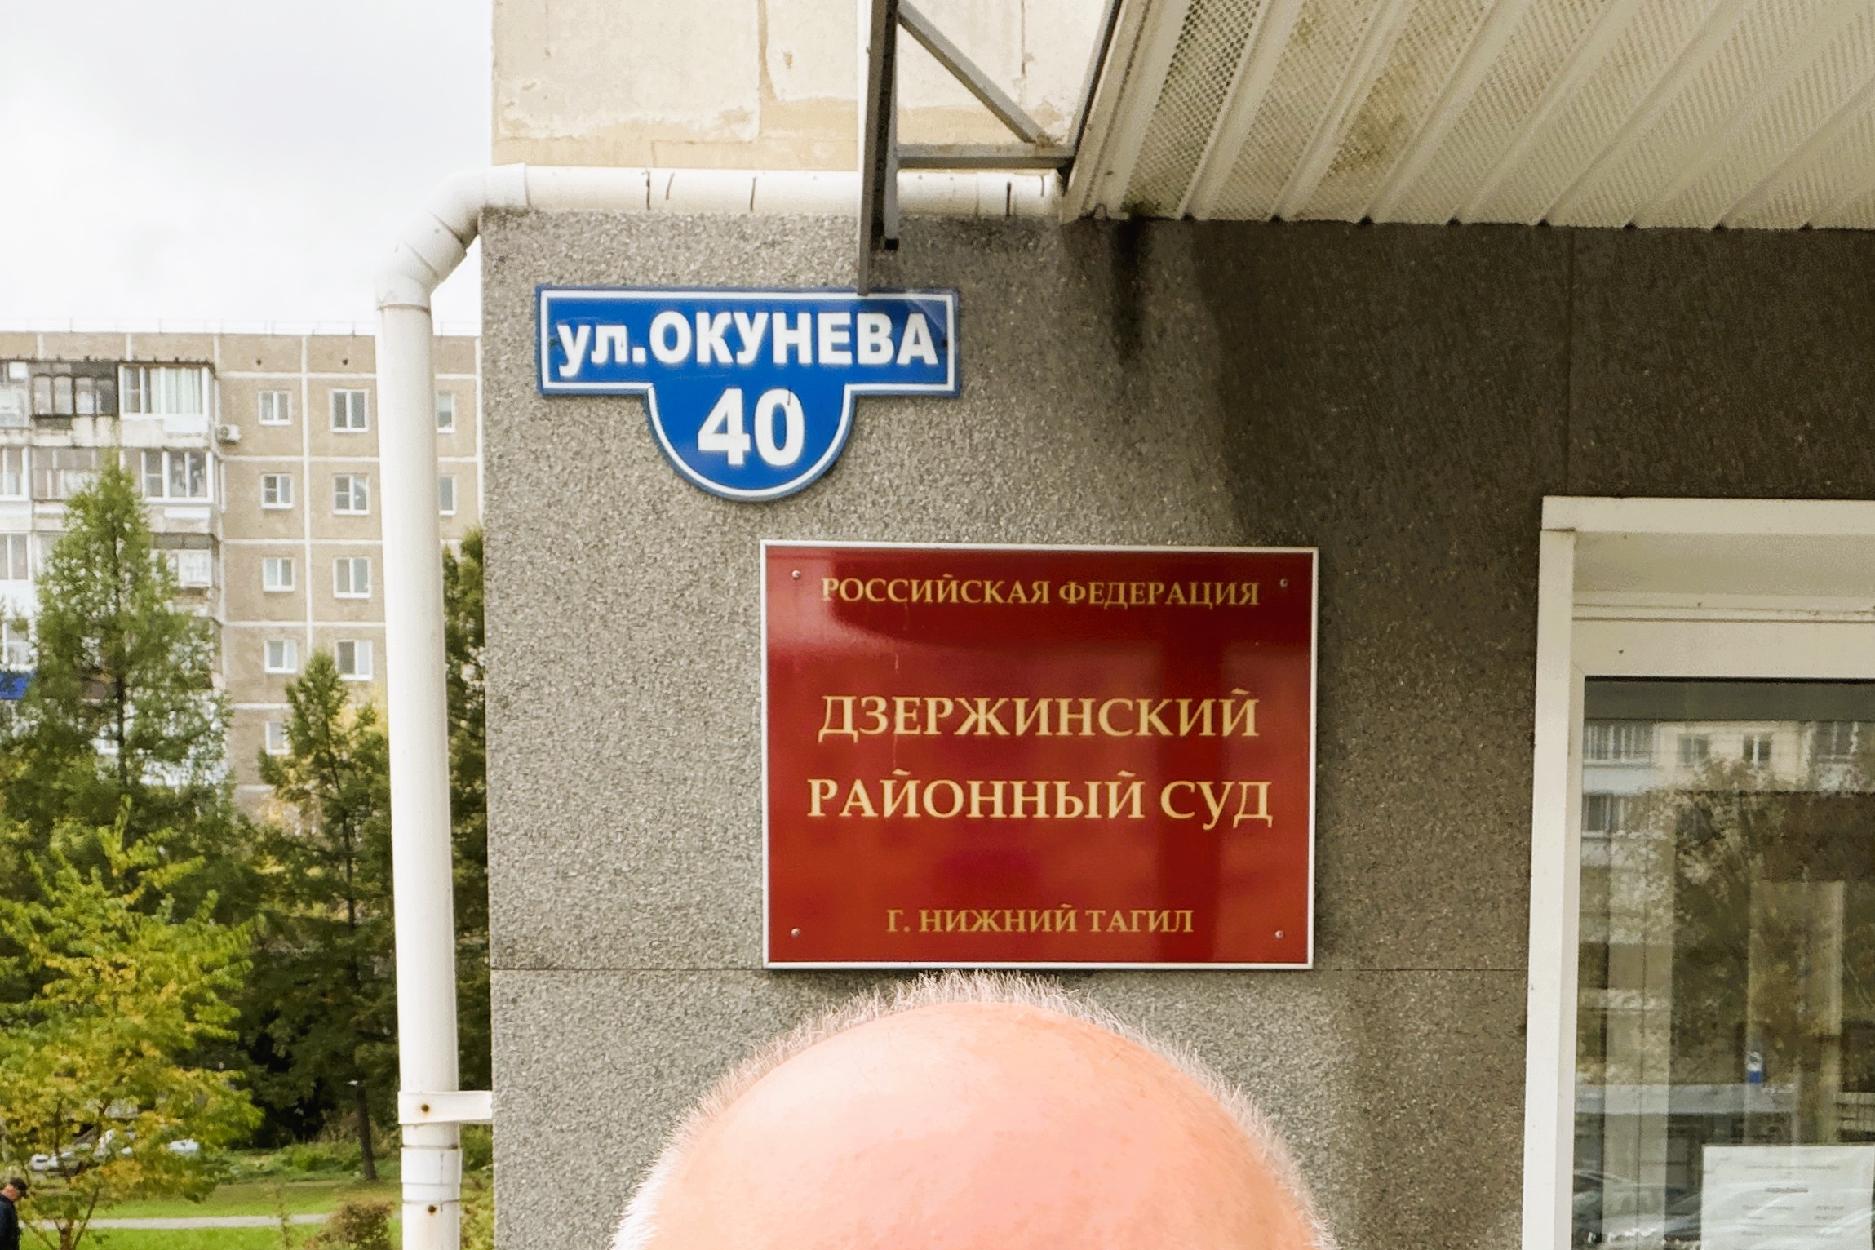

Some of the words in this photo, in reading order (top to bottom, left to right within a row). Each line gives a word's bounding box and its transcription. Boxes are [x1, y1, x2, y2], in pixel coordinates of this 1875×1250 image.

[557, 311, 939, 378] ул.ОКУНЕВА
[697, 387, 805, 467] 40
[821, 573, 1050, 604] РОССИЙСКАЯ
[1059, 580, 1260, 609] ФЕДЕРАЦИЯ
[818, 688, 1260, 743] ДЗЕРЖИНСКИЙ
[807, 768, 1147, 819] РАЙОННЫЙ
[1160, 780, 1273, 831] СУД
[886, 909, 911, 933] Г.
[919, 902, 1078, 933] НИЖНИЙ
[1086, 909, 1194, 933] ТАГИЛ
